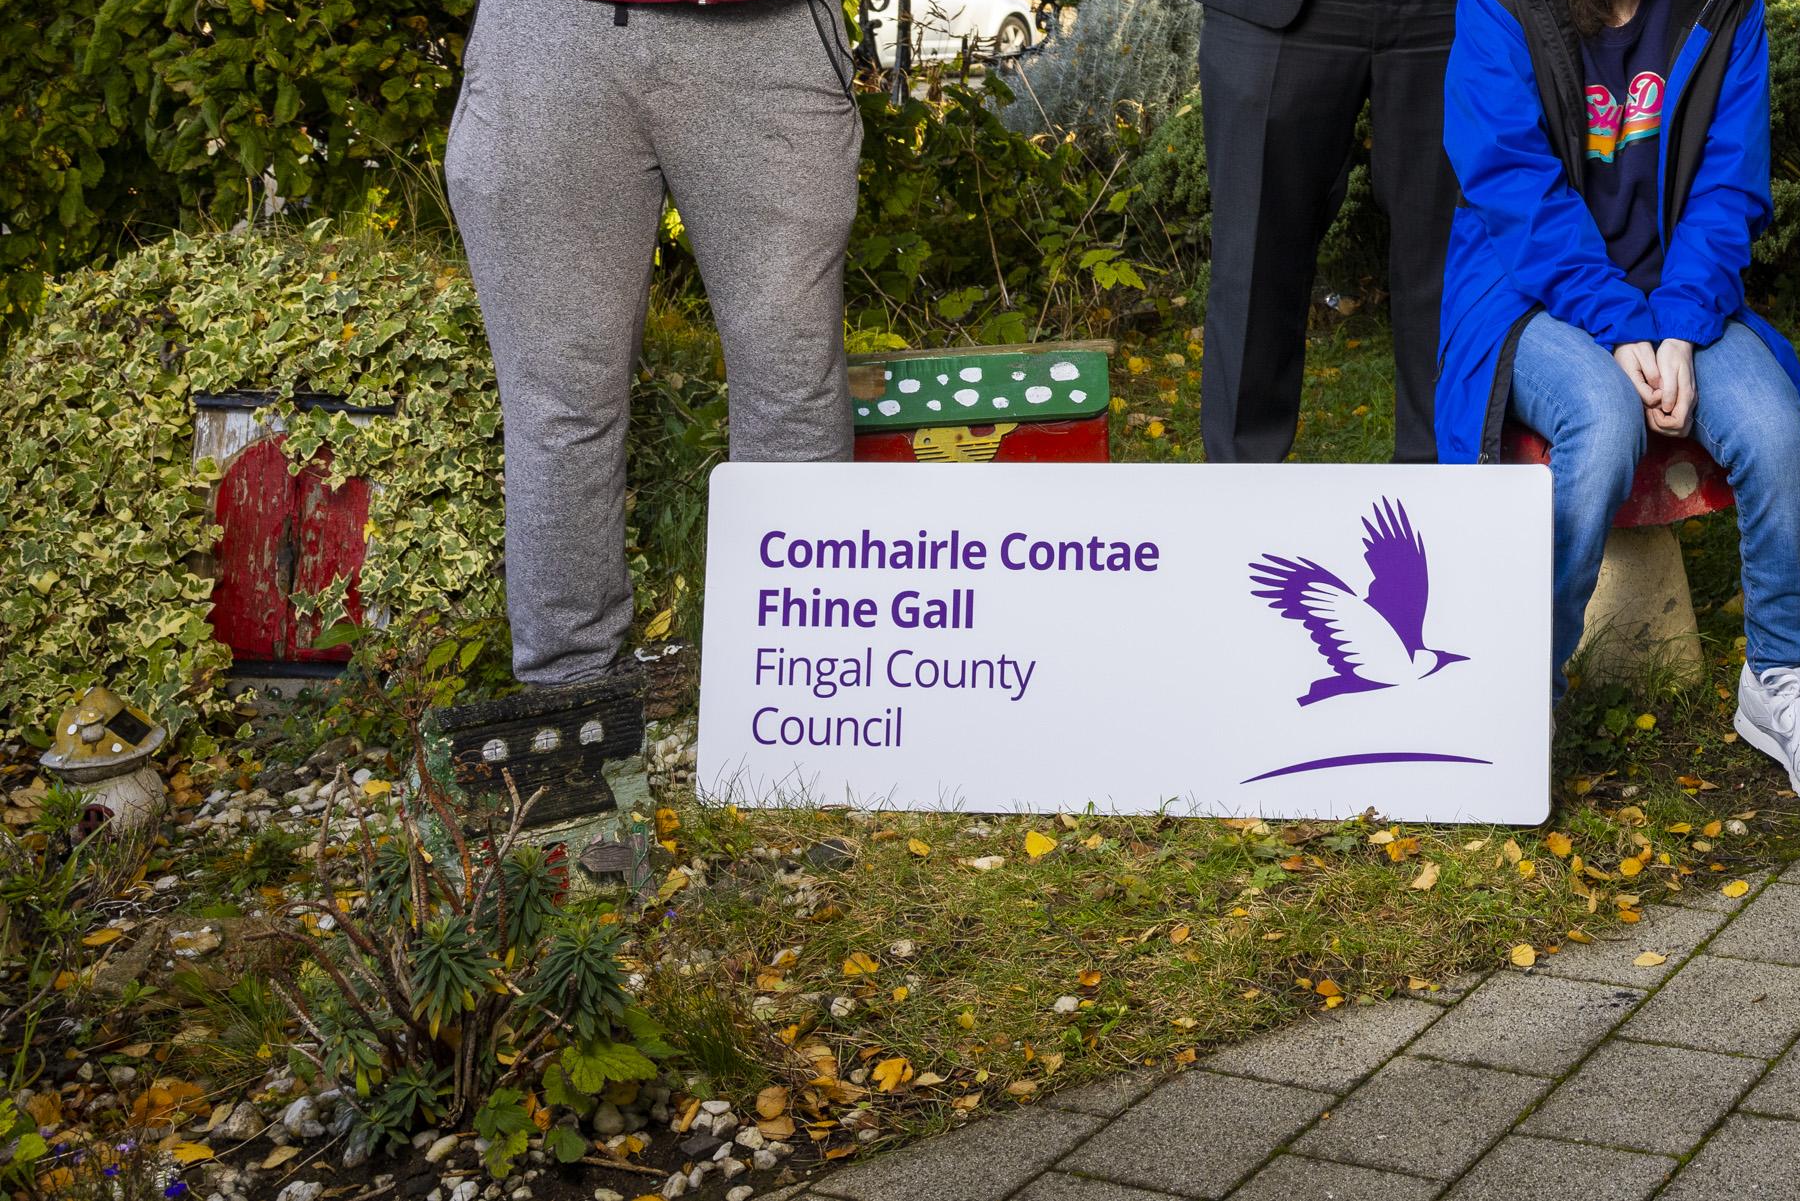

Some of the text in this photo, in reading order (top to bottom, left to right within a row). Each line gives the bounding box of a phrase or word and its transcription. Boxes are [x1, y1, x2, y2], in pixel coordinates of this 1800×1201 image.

[760, 530, 1159, 571] Comhairle Contae
[759, 588, 973, 628] Fhine Gall
[755, 648, 1036, 701] Fingal County
[752, 706, 902, 747] Council
